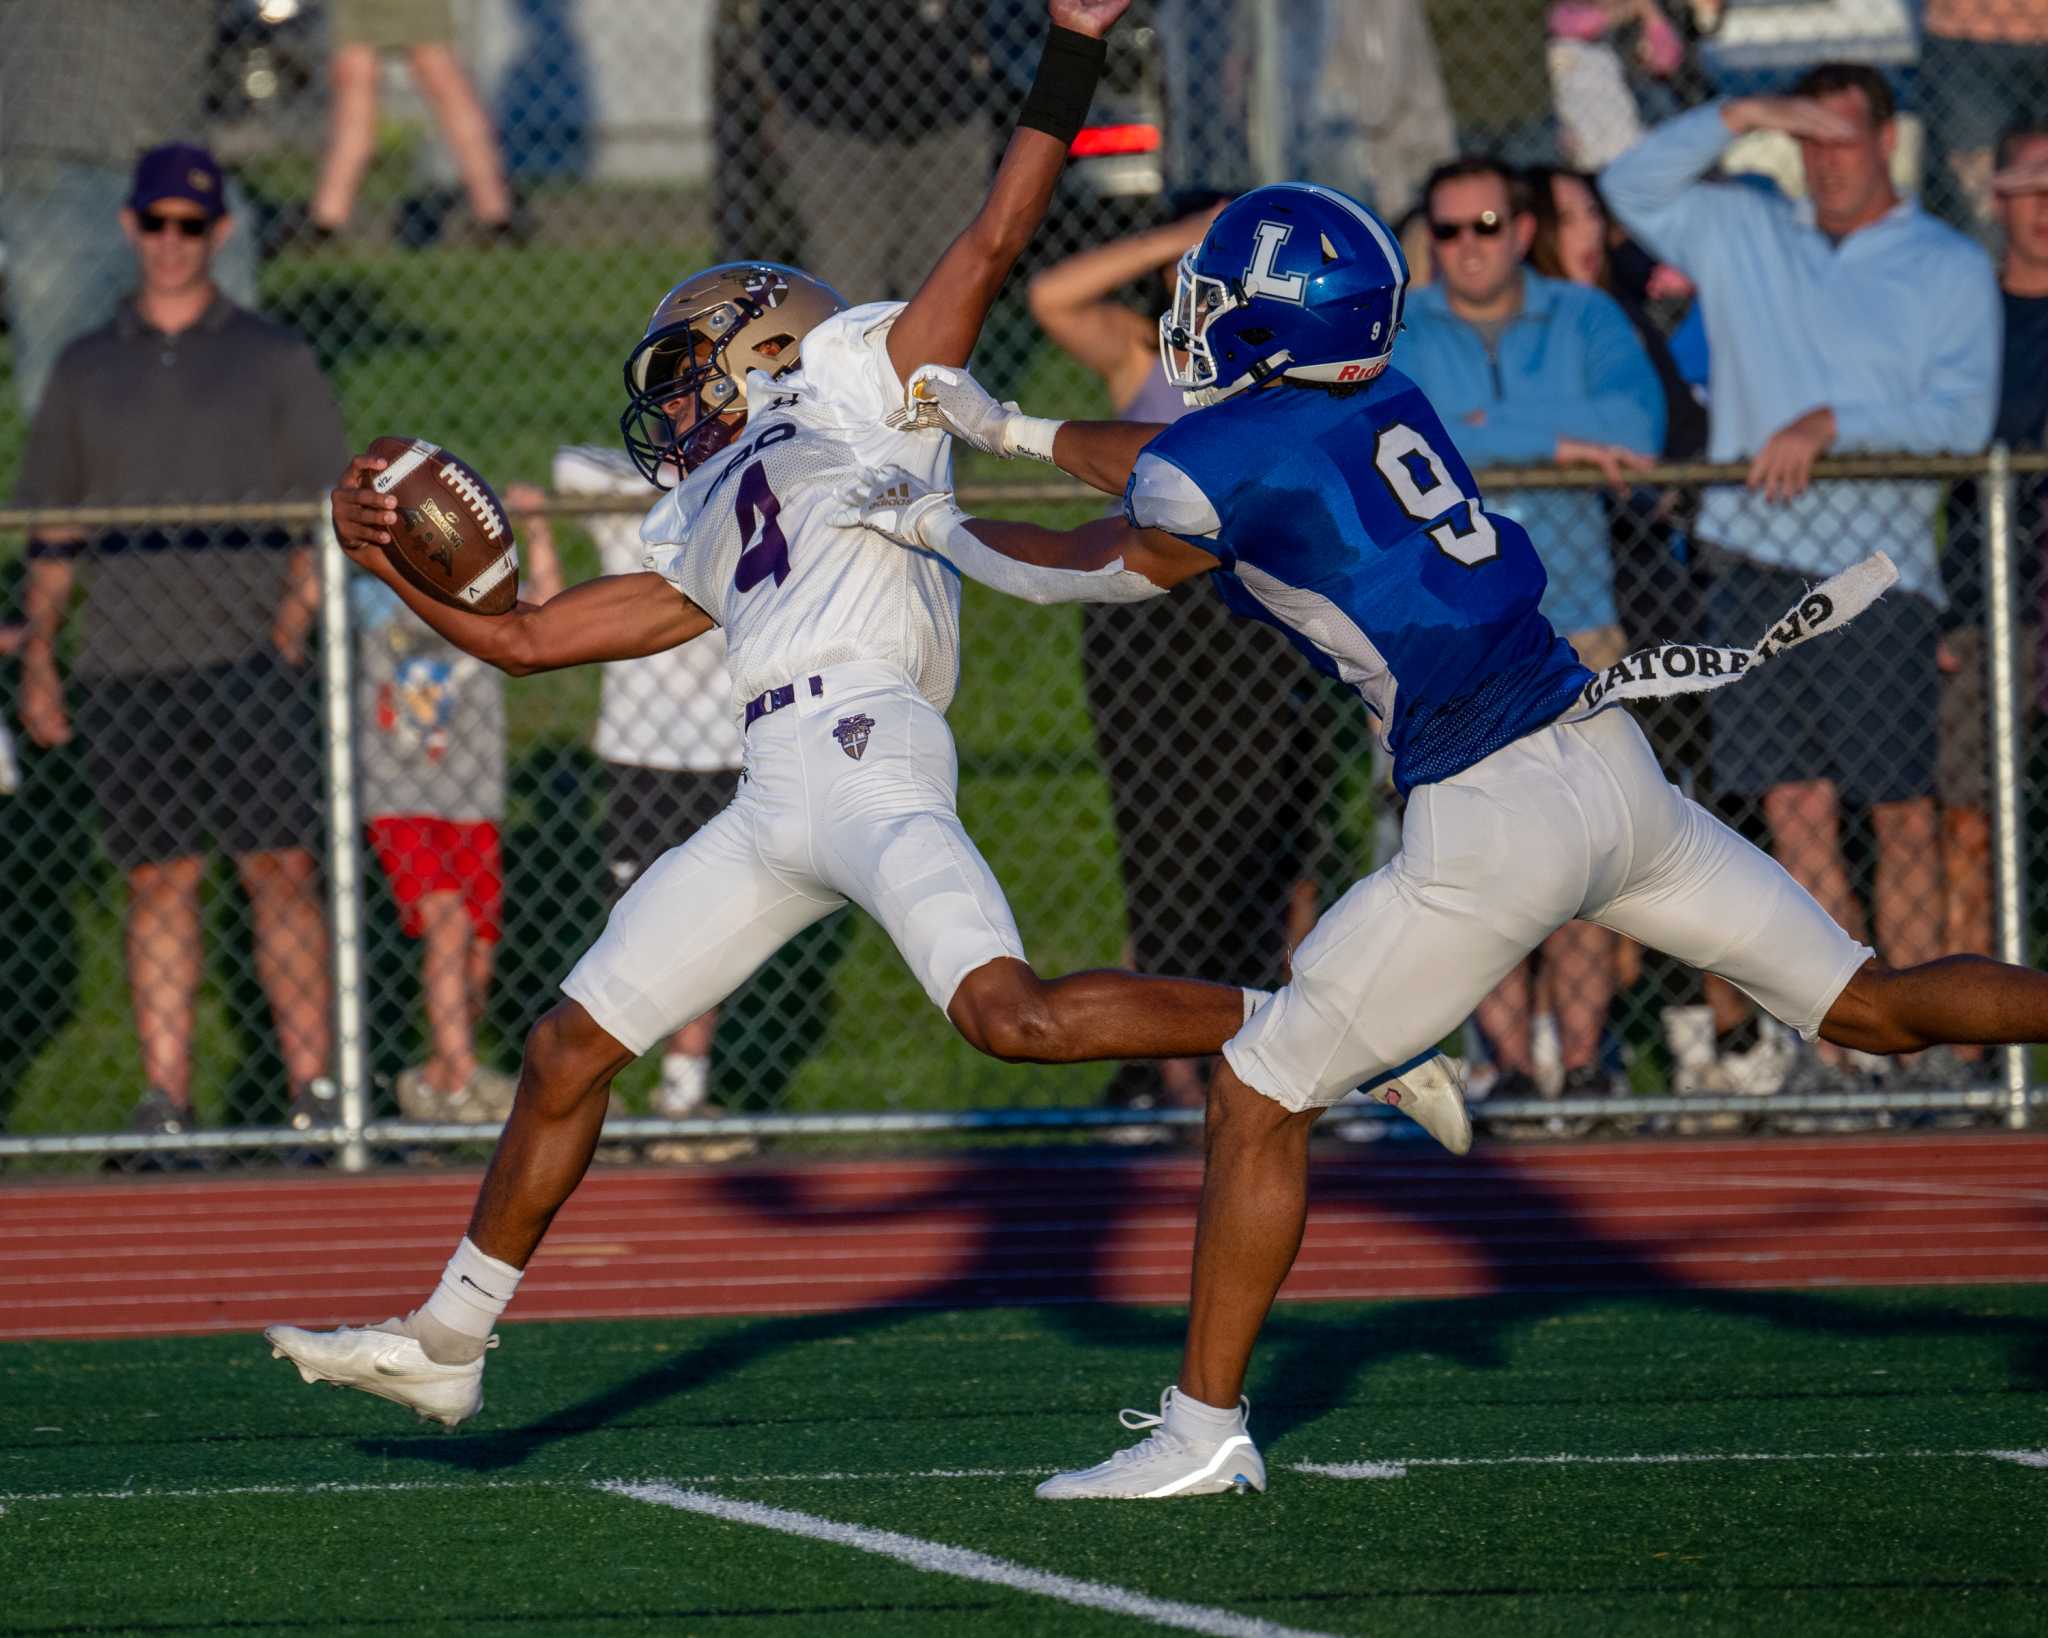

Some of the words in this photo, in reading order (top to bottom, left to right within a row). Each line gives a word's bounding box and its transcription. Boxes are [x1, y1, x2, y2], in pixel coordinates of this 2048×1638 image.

[1242, 219, 1310, 306] L
[1336, 359, 1385, 381] Rid
[1370, 320, 1381, 341] 9
[735, 459, 792, 594] 4
[1373, 420, 1500, 570] 9
